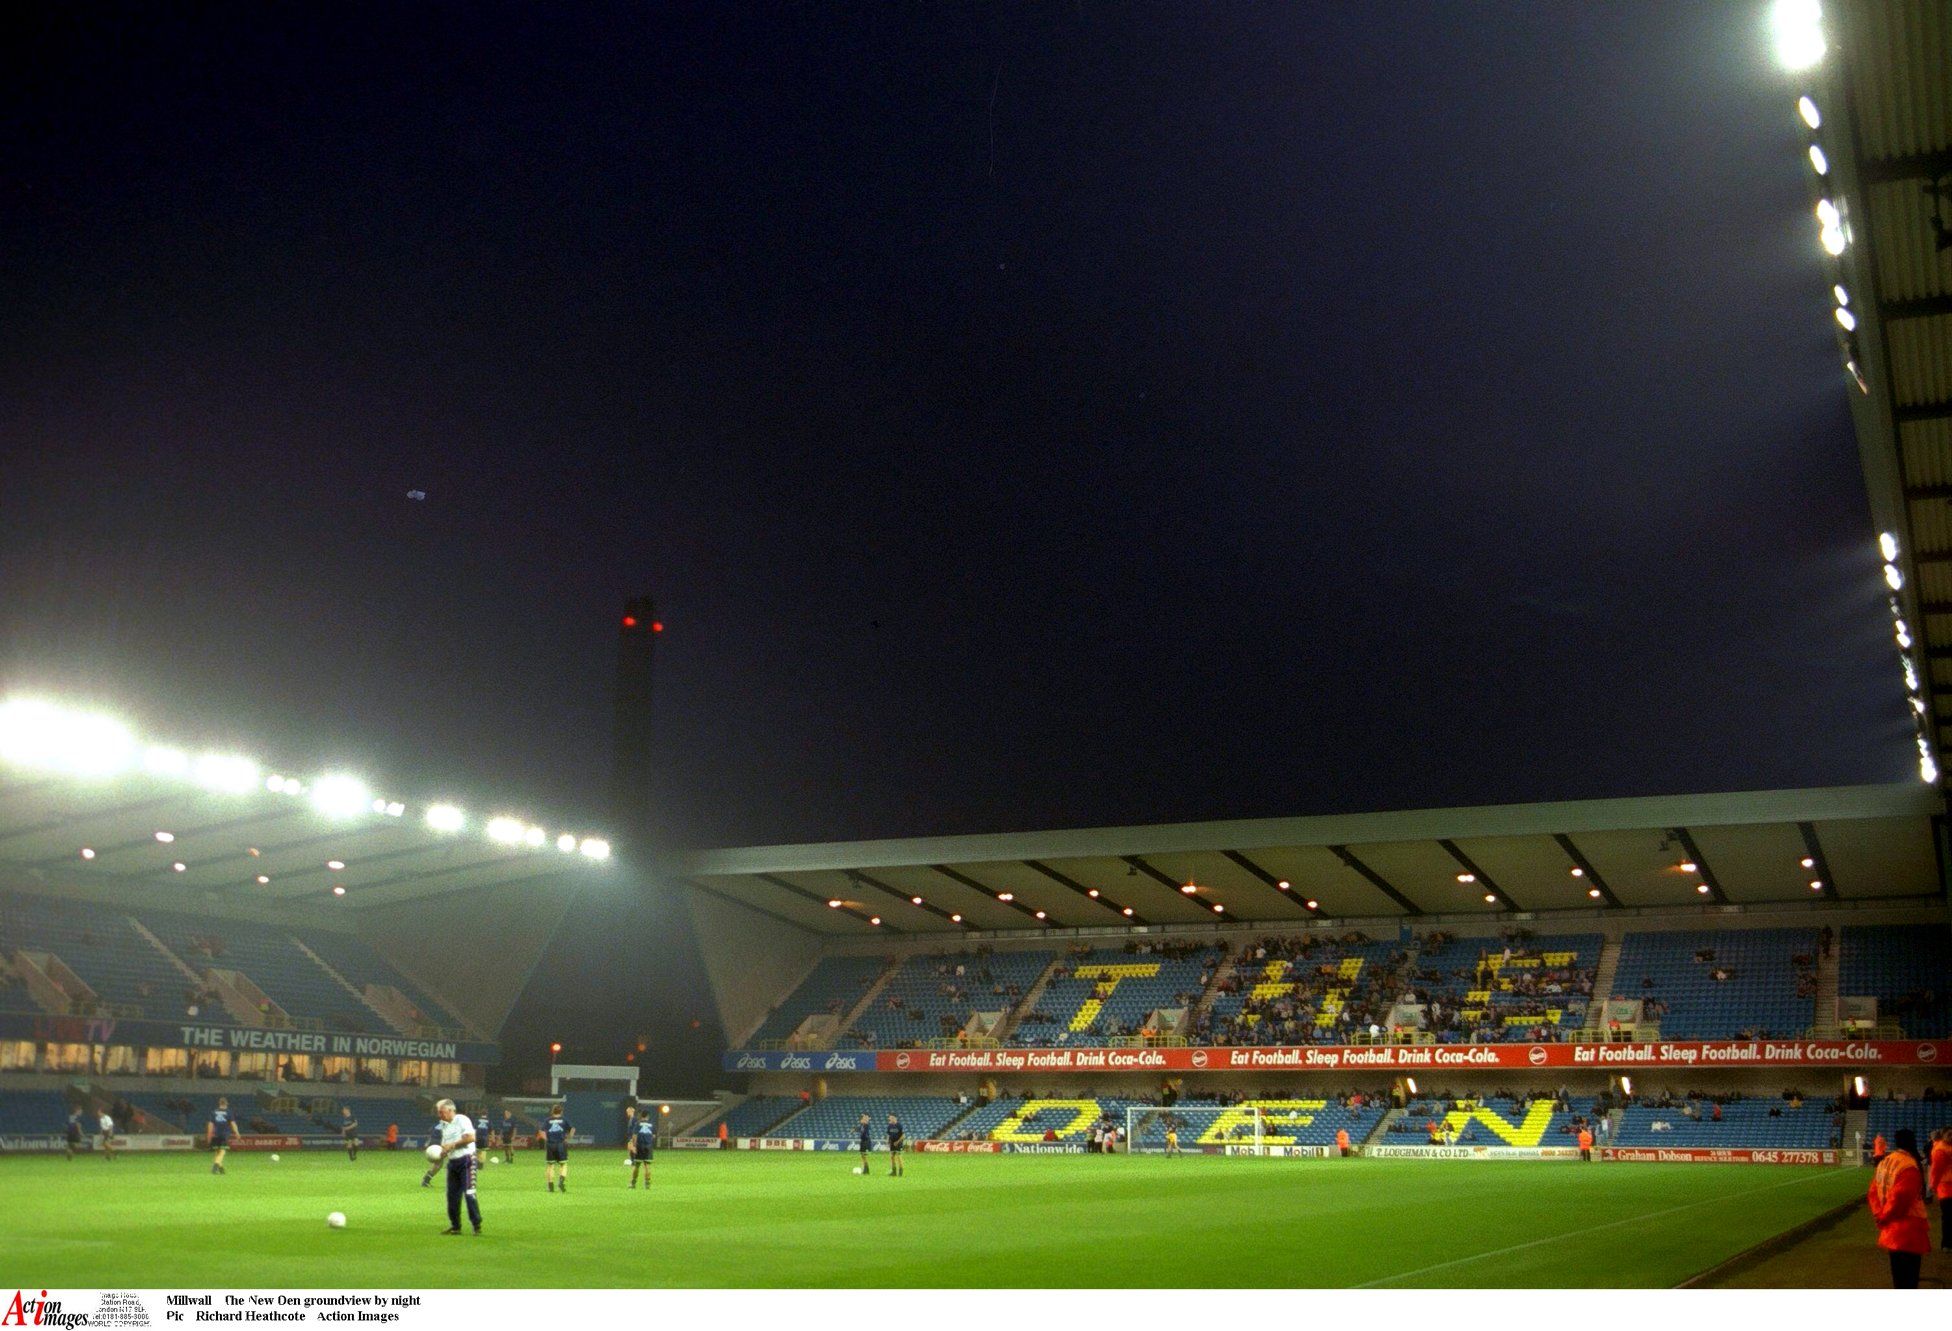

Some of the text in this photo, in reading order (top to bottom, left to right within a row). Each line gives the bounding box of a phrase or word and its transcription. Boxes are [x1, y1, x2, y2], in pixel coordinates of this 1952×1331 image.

[180, 1026, 456, 1059] THE WEATHER IN NORWEGIAN
[929, 1050, 1167, 1069] Eat Football. Sleep Football. Drink Coca-Cola.
[1230, 1047, 1500, 1067] Eat Football. Sleep Football. Drink Coca-Cola.
[1574, 1043, 1882, 1064] Eat Football. Sleep Football. Drink Coca-Cola.
[991, 1099, 1557, 1147] DEN
[1013, 1142, 1084, 1154] Nationwide
[1283, 1146, 1315, 1158] Mobil
[1384, 1148, 1430, 1158] LOUGHMAN
[1432, 1149, 1437, 1157] &
[1439, 1148, 1451, 1157] CO
[1618, 1150, 1656, 1161] Graham
[1658, 1151, 1692, 1162] Dobson
[1752, 1151, 1778, 1163] 0645
[1782, 1151, 1819, 1163] 277378
